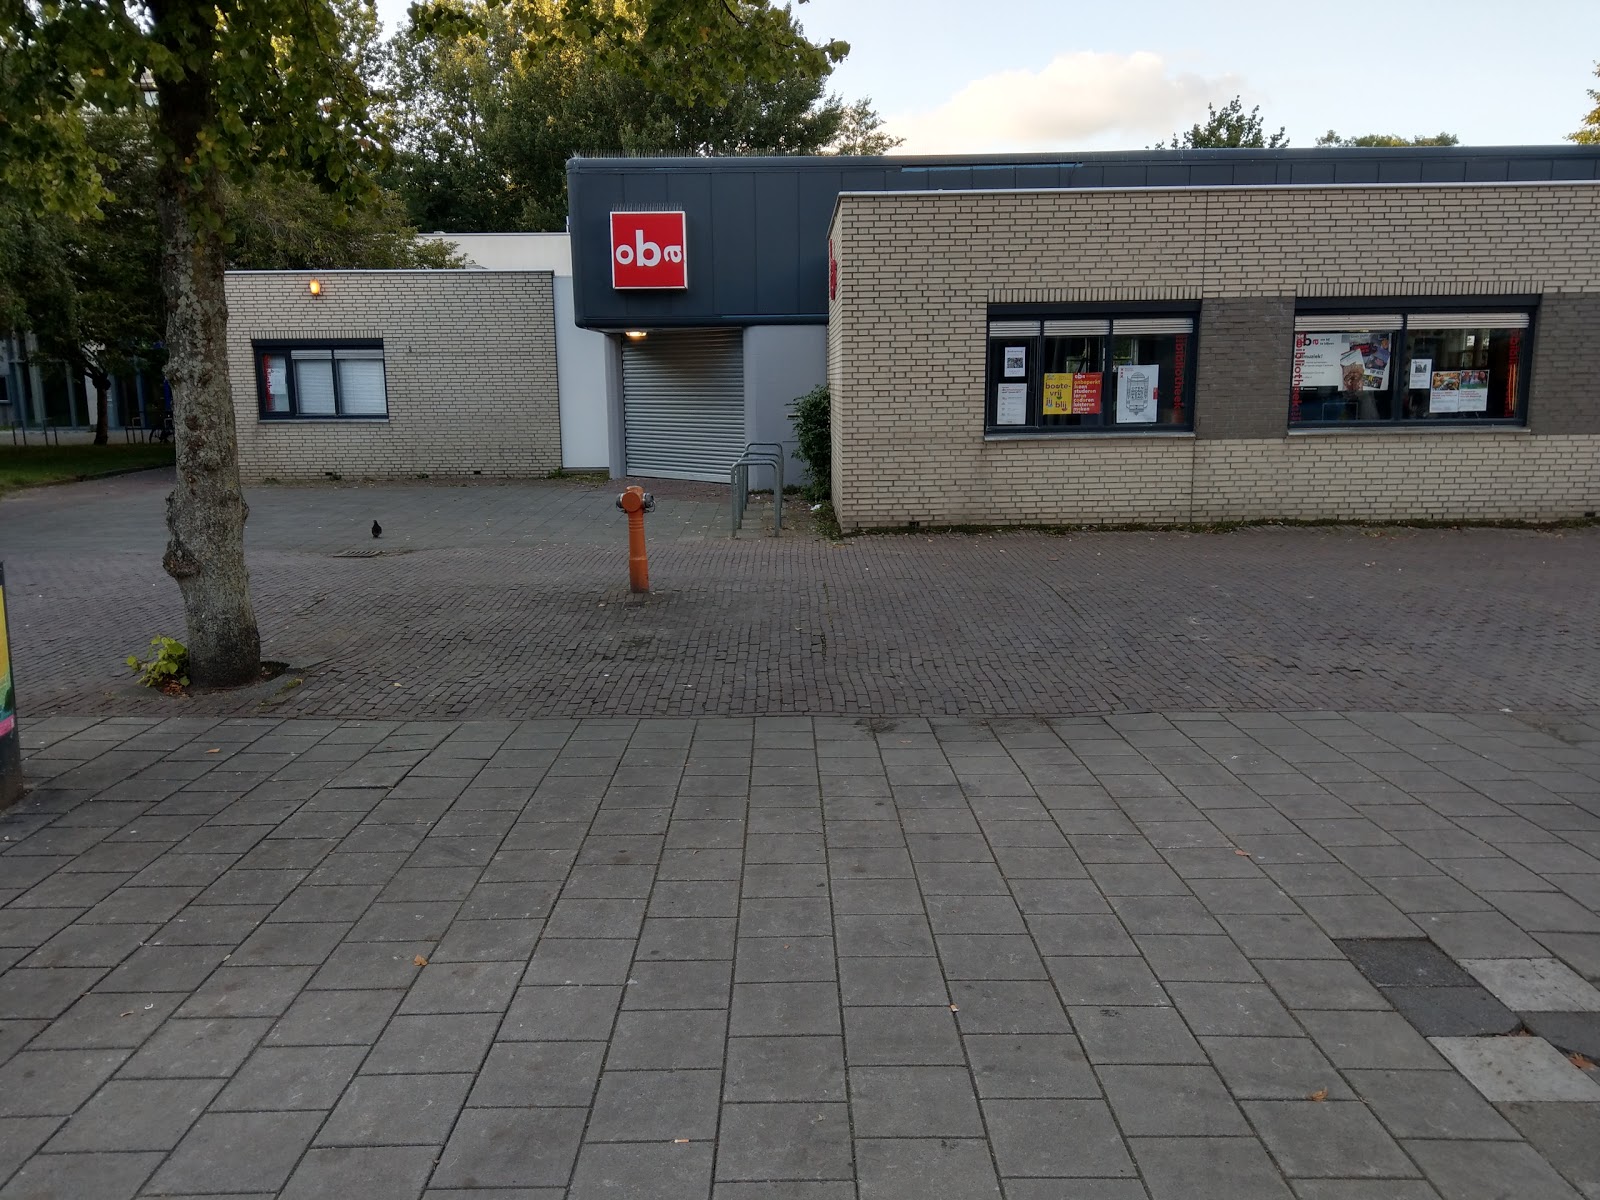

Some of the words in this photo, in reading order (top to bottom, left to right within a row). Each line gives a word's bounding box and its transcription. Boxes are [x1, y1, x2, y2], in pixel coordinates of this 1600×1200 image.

[615, 229, 682, 267] oba
[1173, 342, 1185, 409] bibliotheek
[1049, 389, 1063, 400] vrij
[1055, 401, 1068, 411] blij
